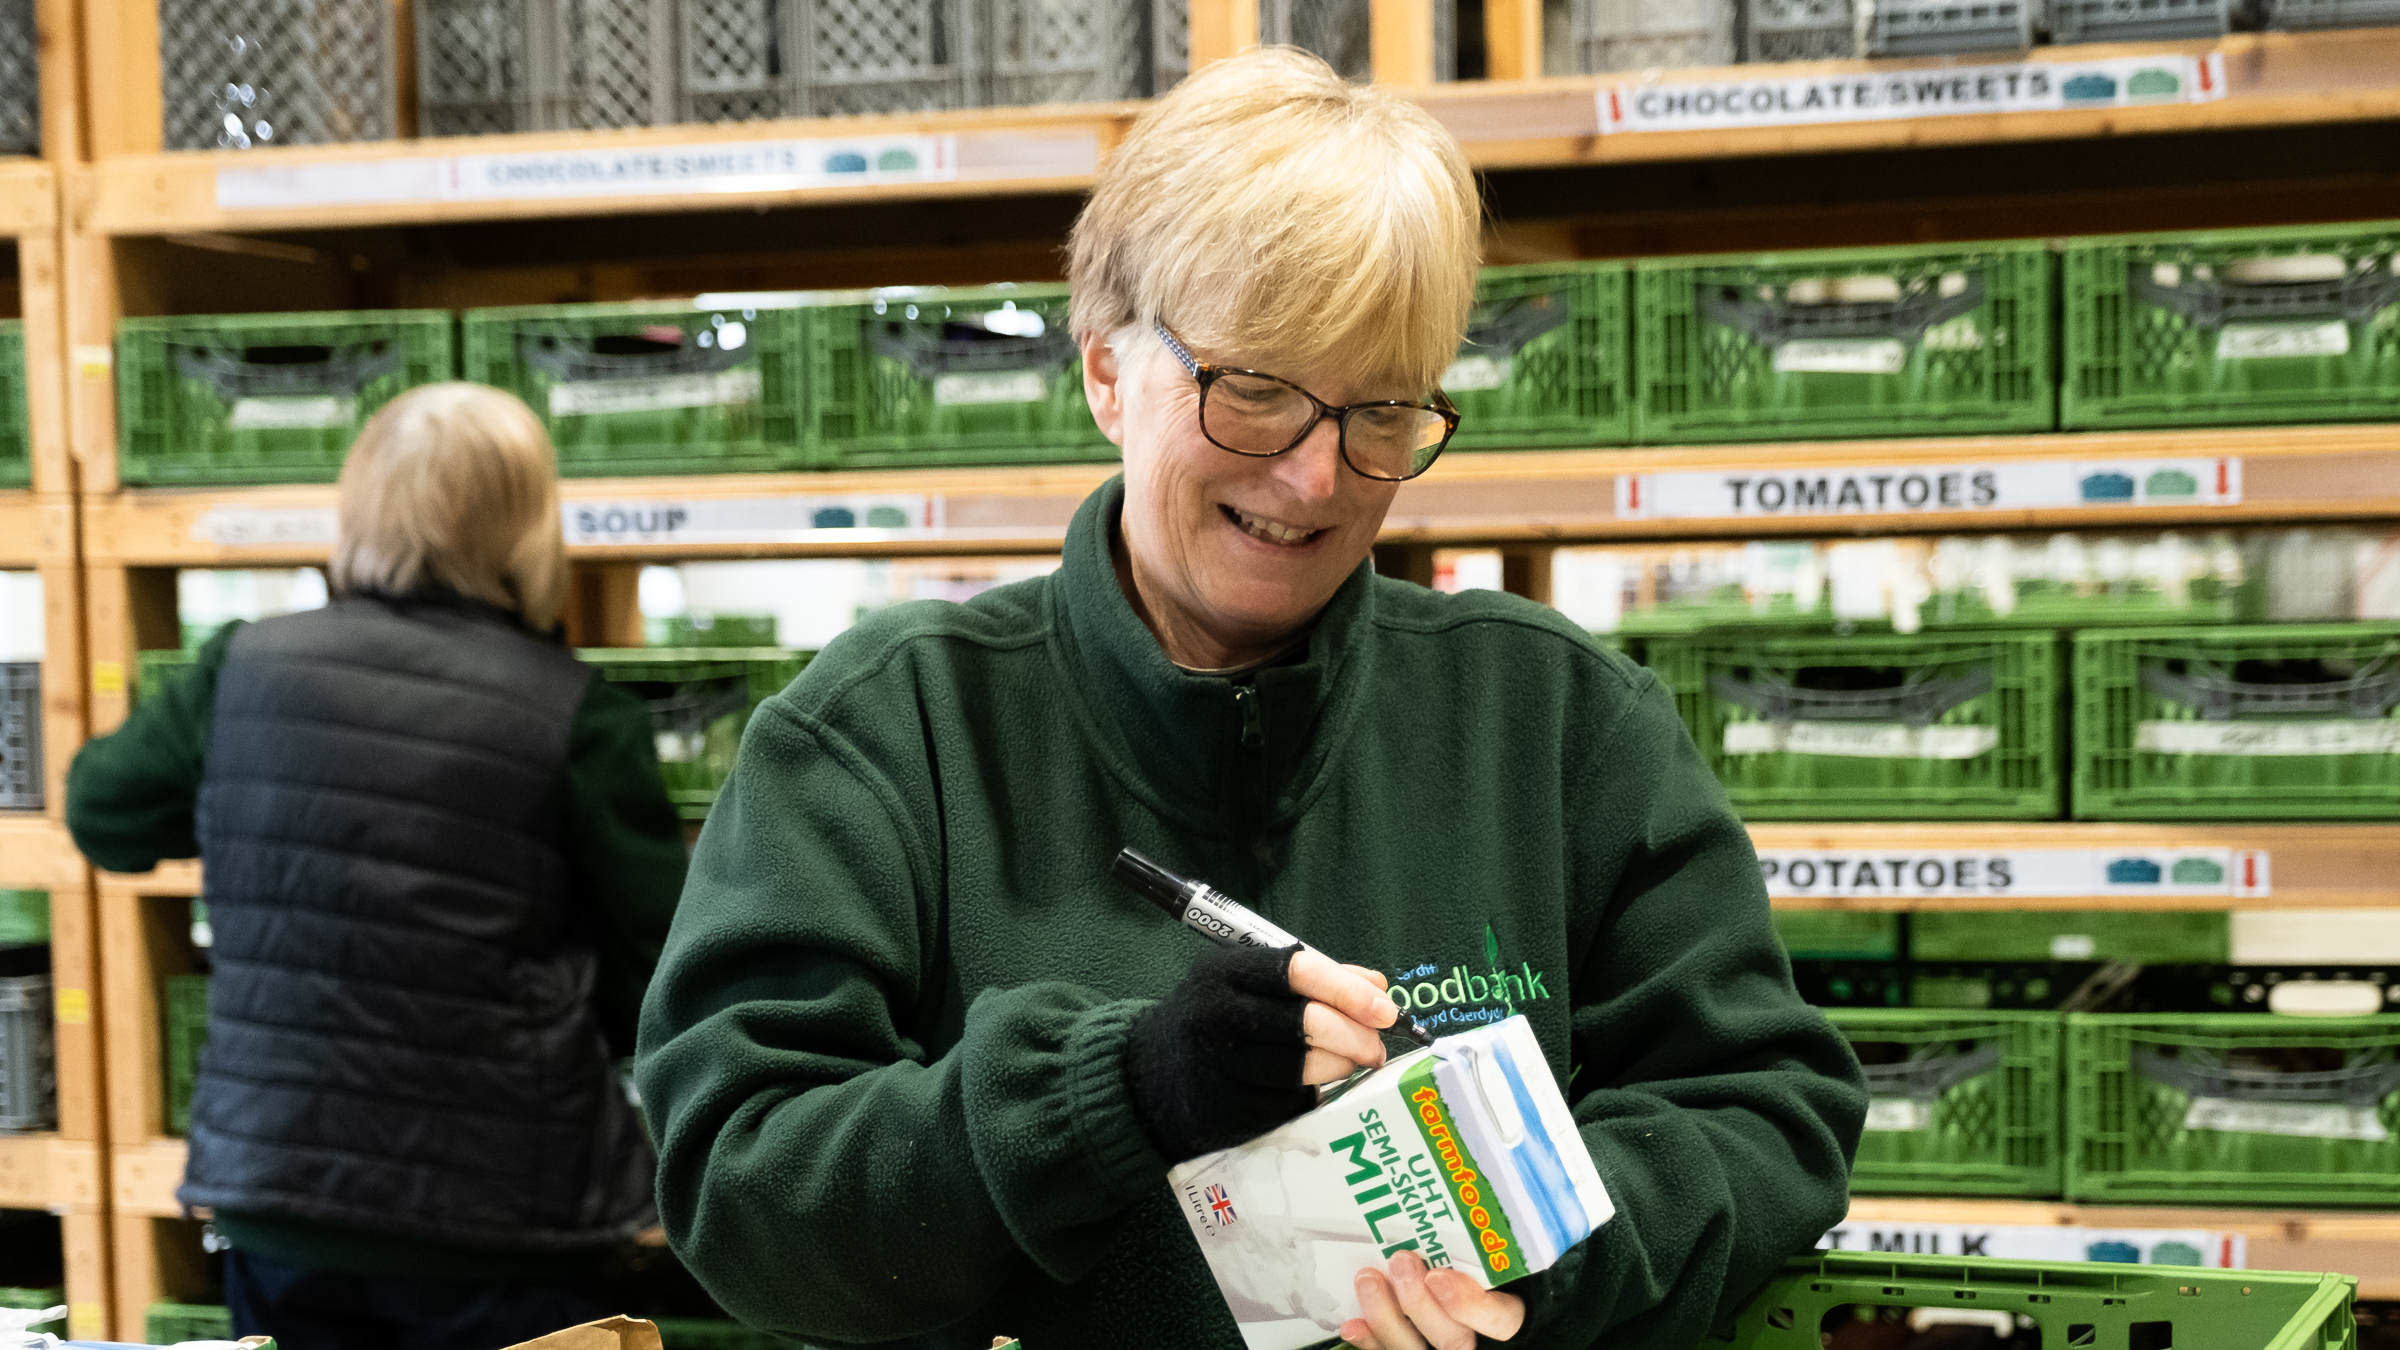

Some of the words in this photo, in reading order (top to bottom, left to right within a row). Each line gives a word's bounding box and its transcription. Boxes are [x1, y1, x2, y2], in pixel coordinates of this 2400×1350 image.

[1725, 470, 1999, 511] TOMATOES
[576, 506, 688, 534] SOUP
[1759, 857, 2013, 889] POTATOES
[1187, 907, 1235, 938] 2000
[1386, 961, 1550, 1011] oodbank
[1358, 1108, 1454, 1270] SEMI-SKIMME
[1407, 1153, 1454, 1222] UHT
[1411, 1086, 1510, 1271] farmfoods
[1188, 1191, 1208, 1224] Litre
